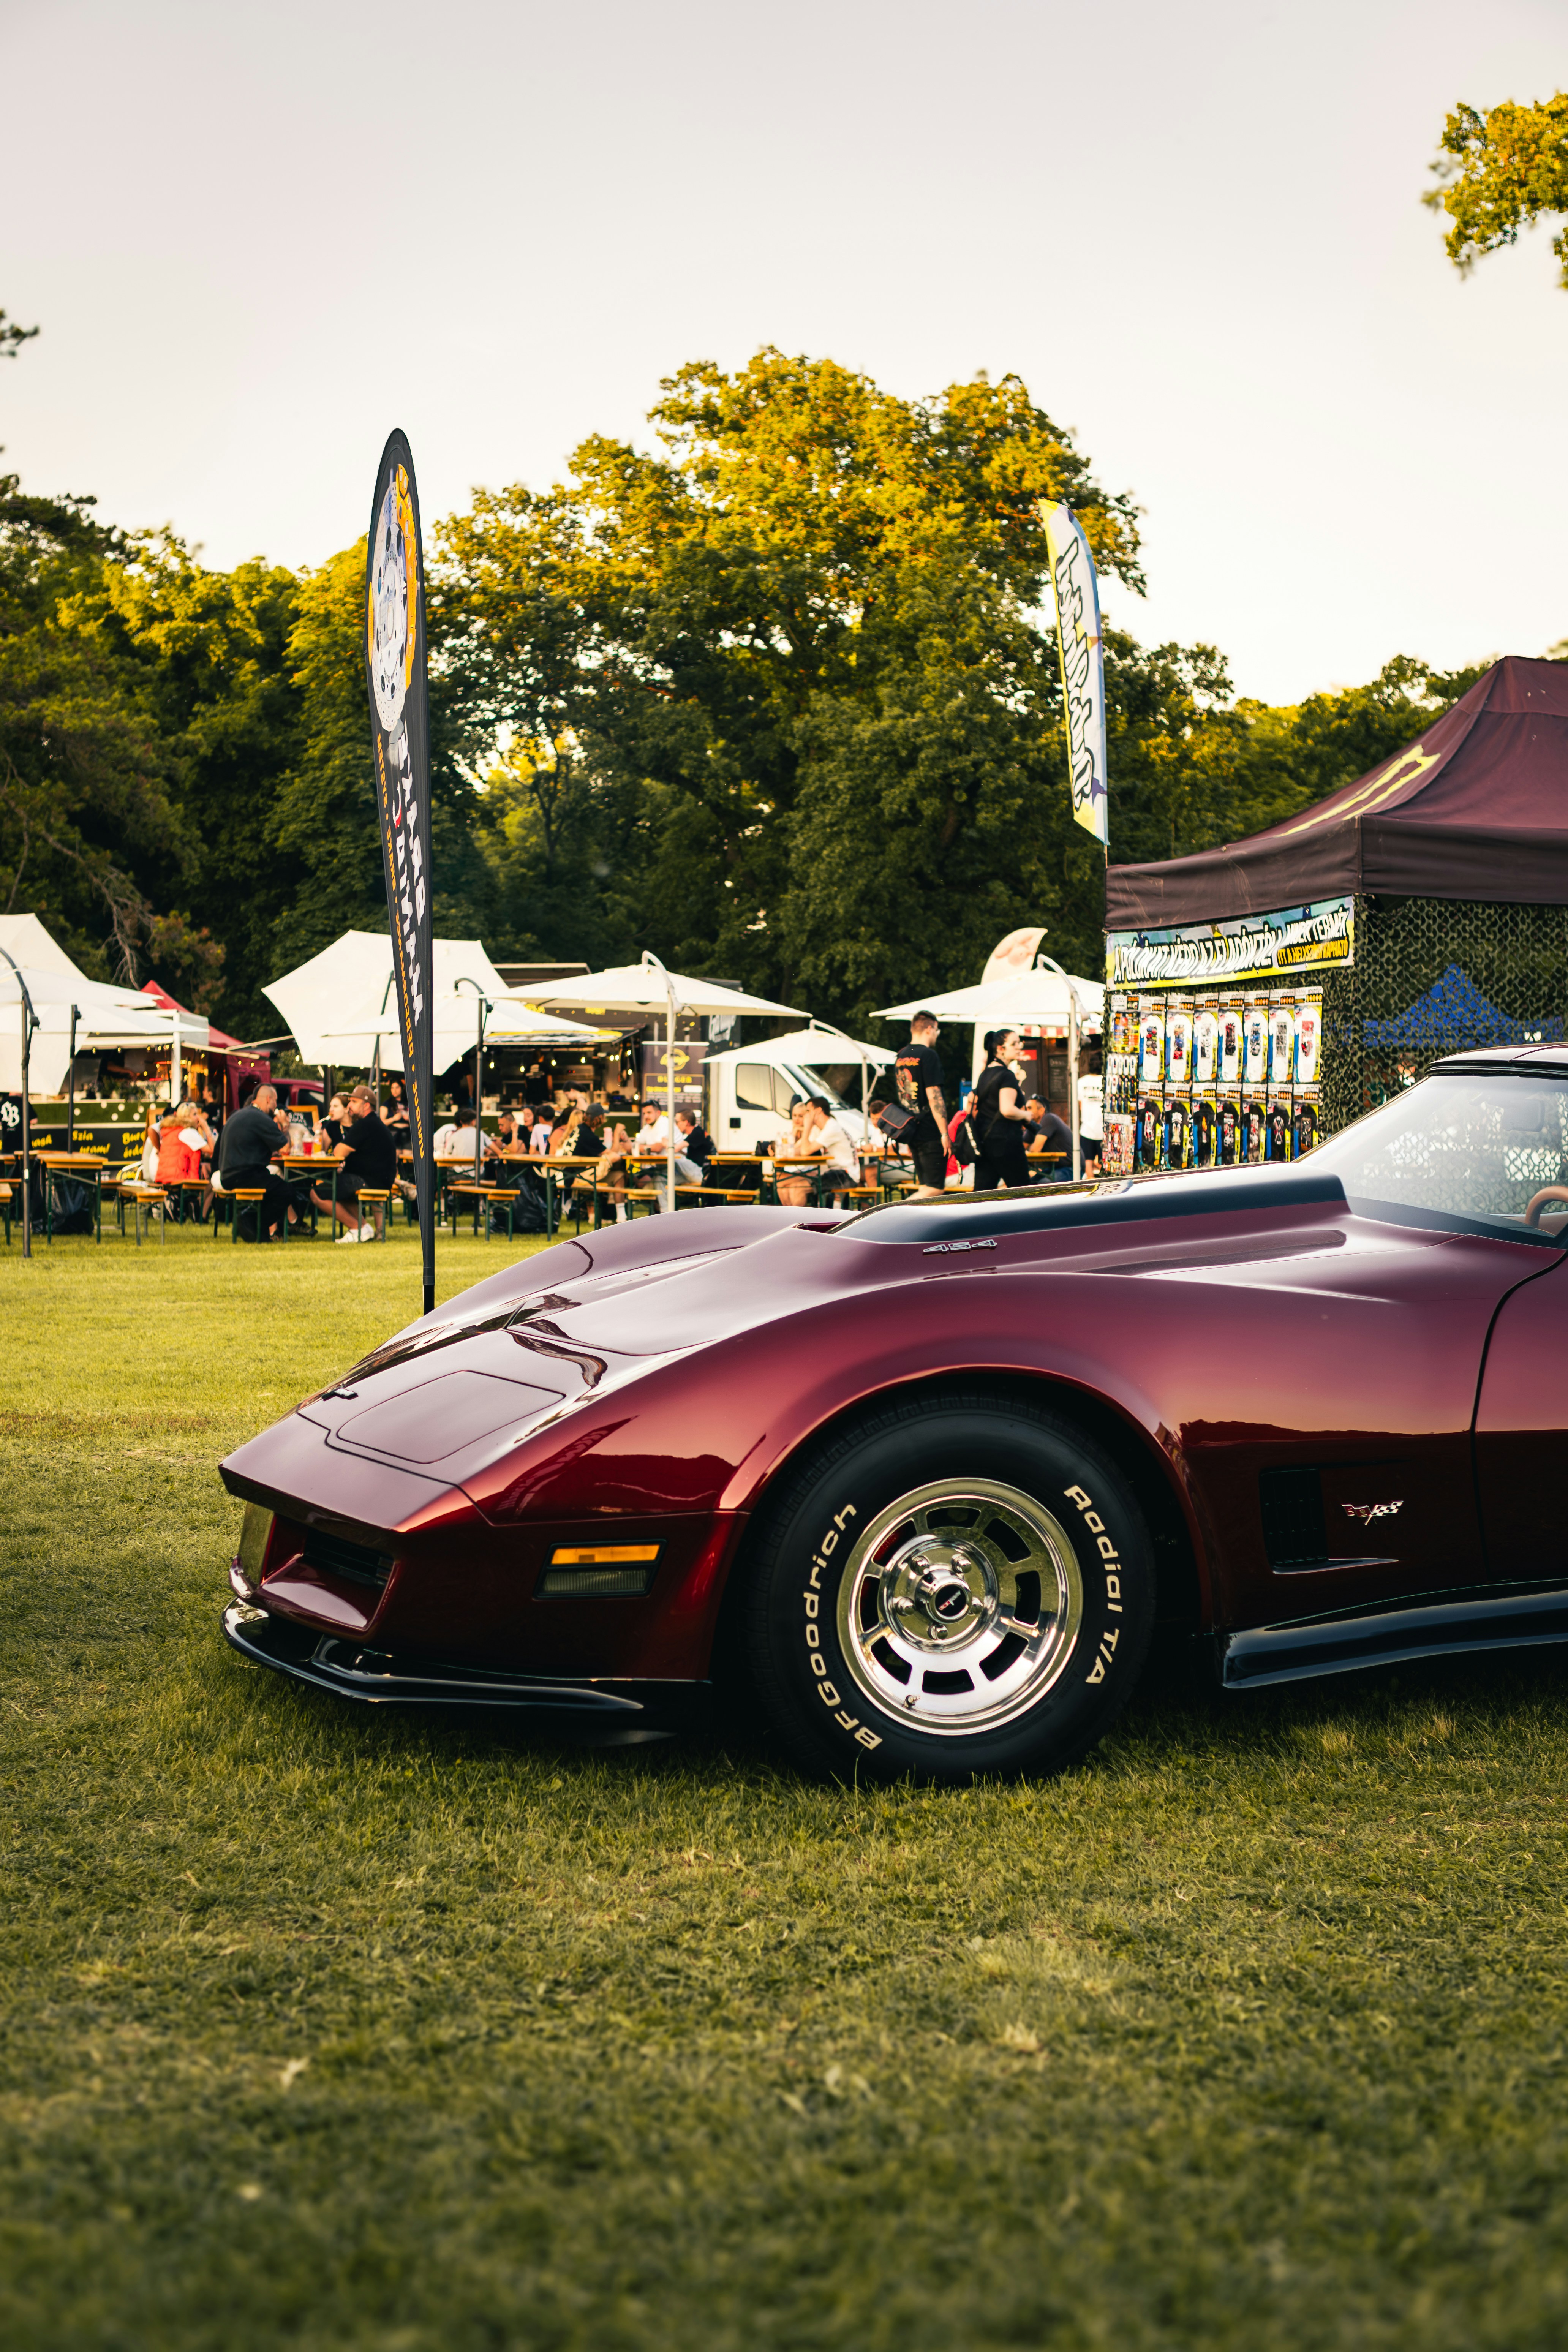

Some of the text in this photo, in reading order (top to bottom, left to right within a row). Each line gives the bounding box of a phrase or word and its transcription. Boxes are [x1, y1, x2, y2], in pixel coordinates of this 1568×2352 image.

[1312, 907, 1349, 940] TERMÉK
[1114, 946, 1122, 982] A
[1161, 937, 1199, 978] KÉRD
[1191, 940, 1214, 975] AZ
[1278, 948, 1287, 965] ITT
[1288, 947, 1293, 964] A
[1322, 936, 1348, 959] KAPHATÓ
[923, 1239, 998, 1252] 454
[1064, 1484, 1123, 1684] Radial T/A
[803, 1504, 883, 1750] BFGoodrich
